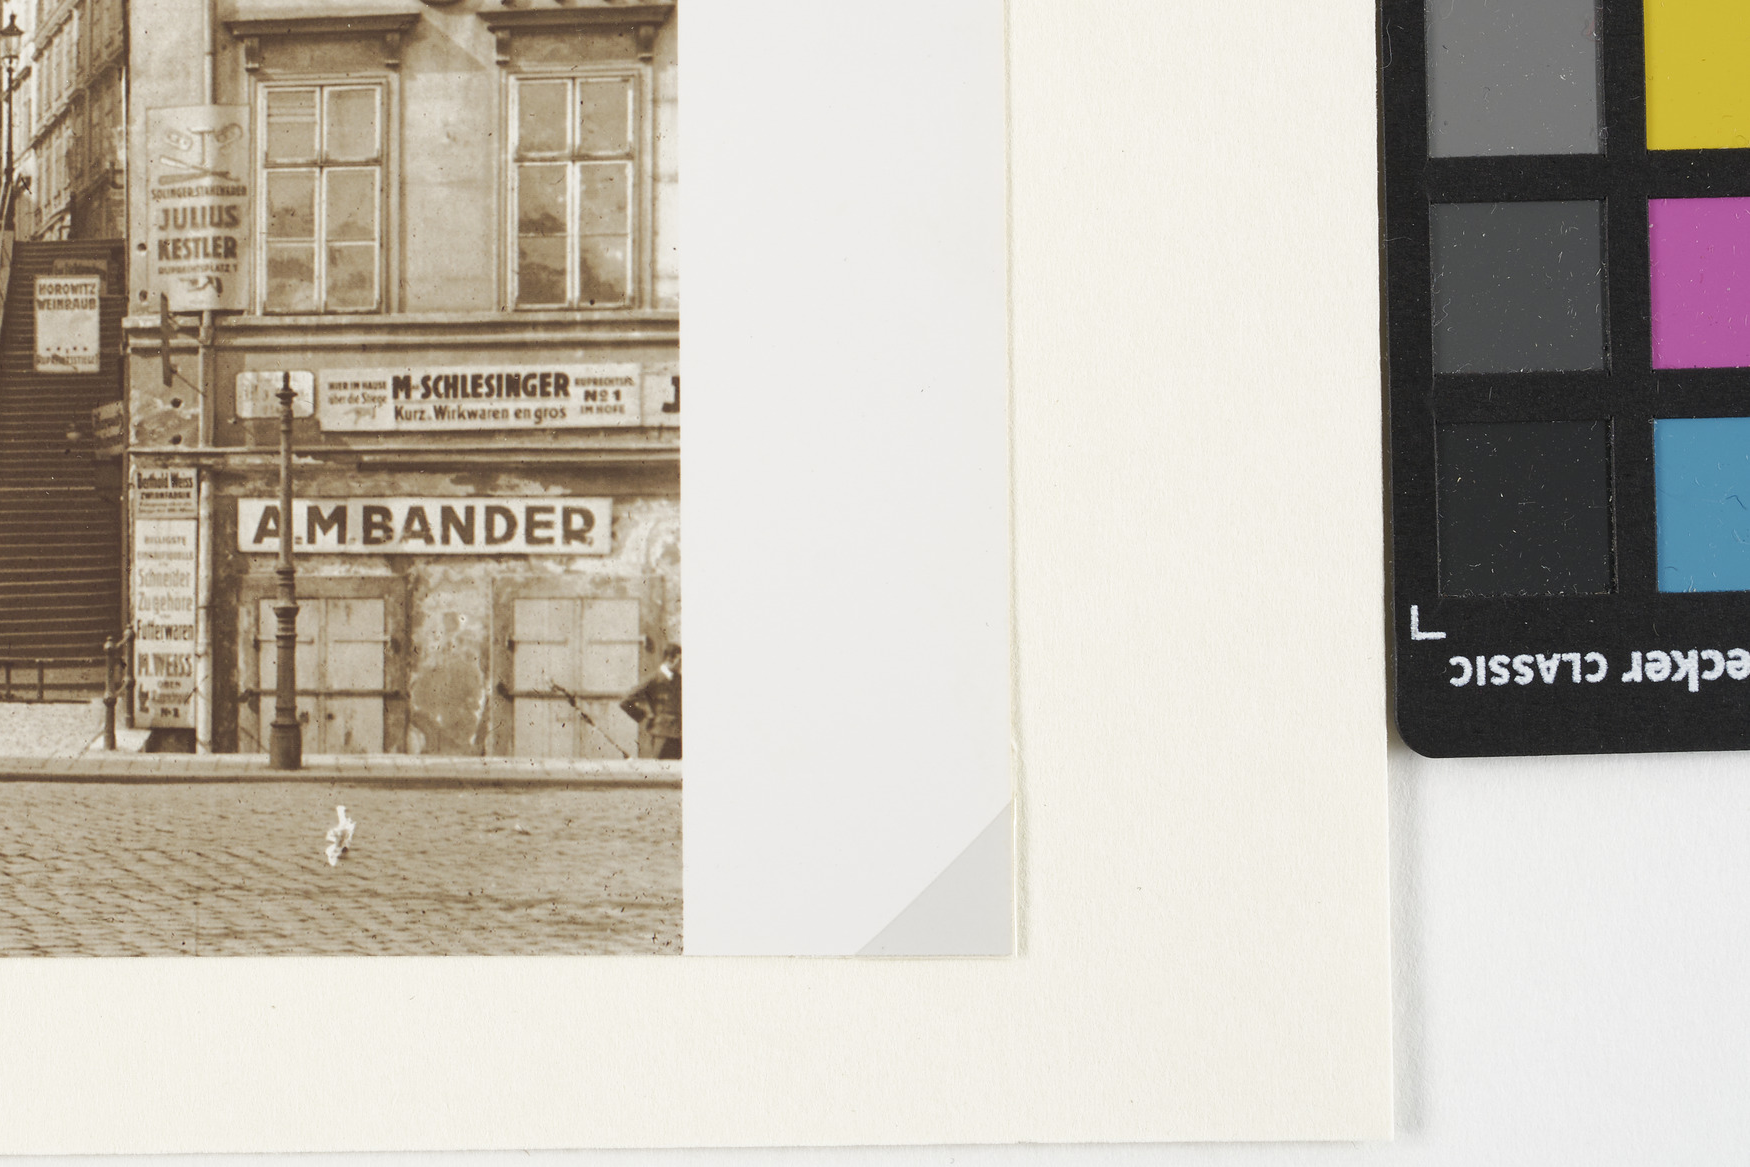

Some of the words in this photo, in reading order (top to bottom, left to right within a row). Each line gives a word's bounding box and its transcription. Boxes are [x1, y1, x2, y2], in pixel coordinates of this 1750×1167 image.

[158, 205, 241, 231] JULIUS
[158, 235, 238, 261] KESTLER
[38, 282, 96, 296] HOROWITZ
[420, 372, 571, 399] SCHLESINGER
[612, 389, 622, 402] 1
[433, 405, 509, 421] Wirkwaren
[514, 407, 531, 420] en
[534, 406, 567, 424] gros
[1449, 651, 1608, 688] CLASSIC
[1621, 648, 1750, 693] ecker
